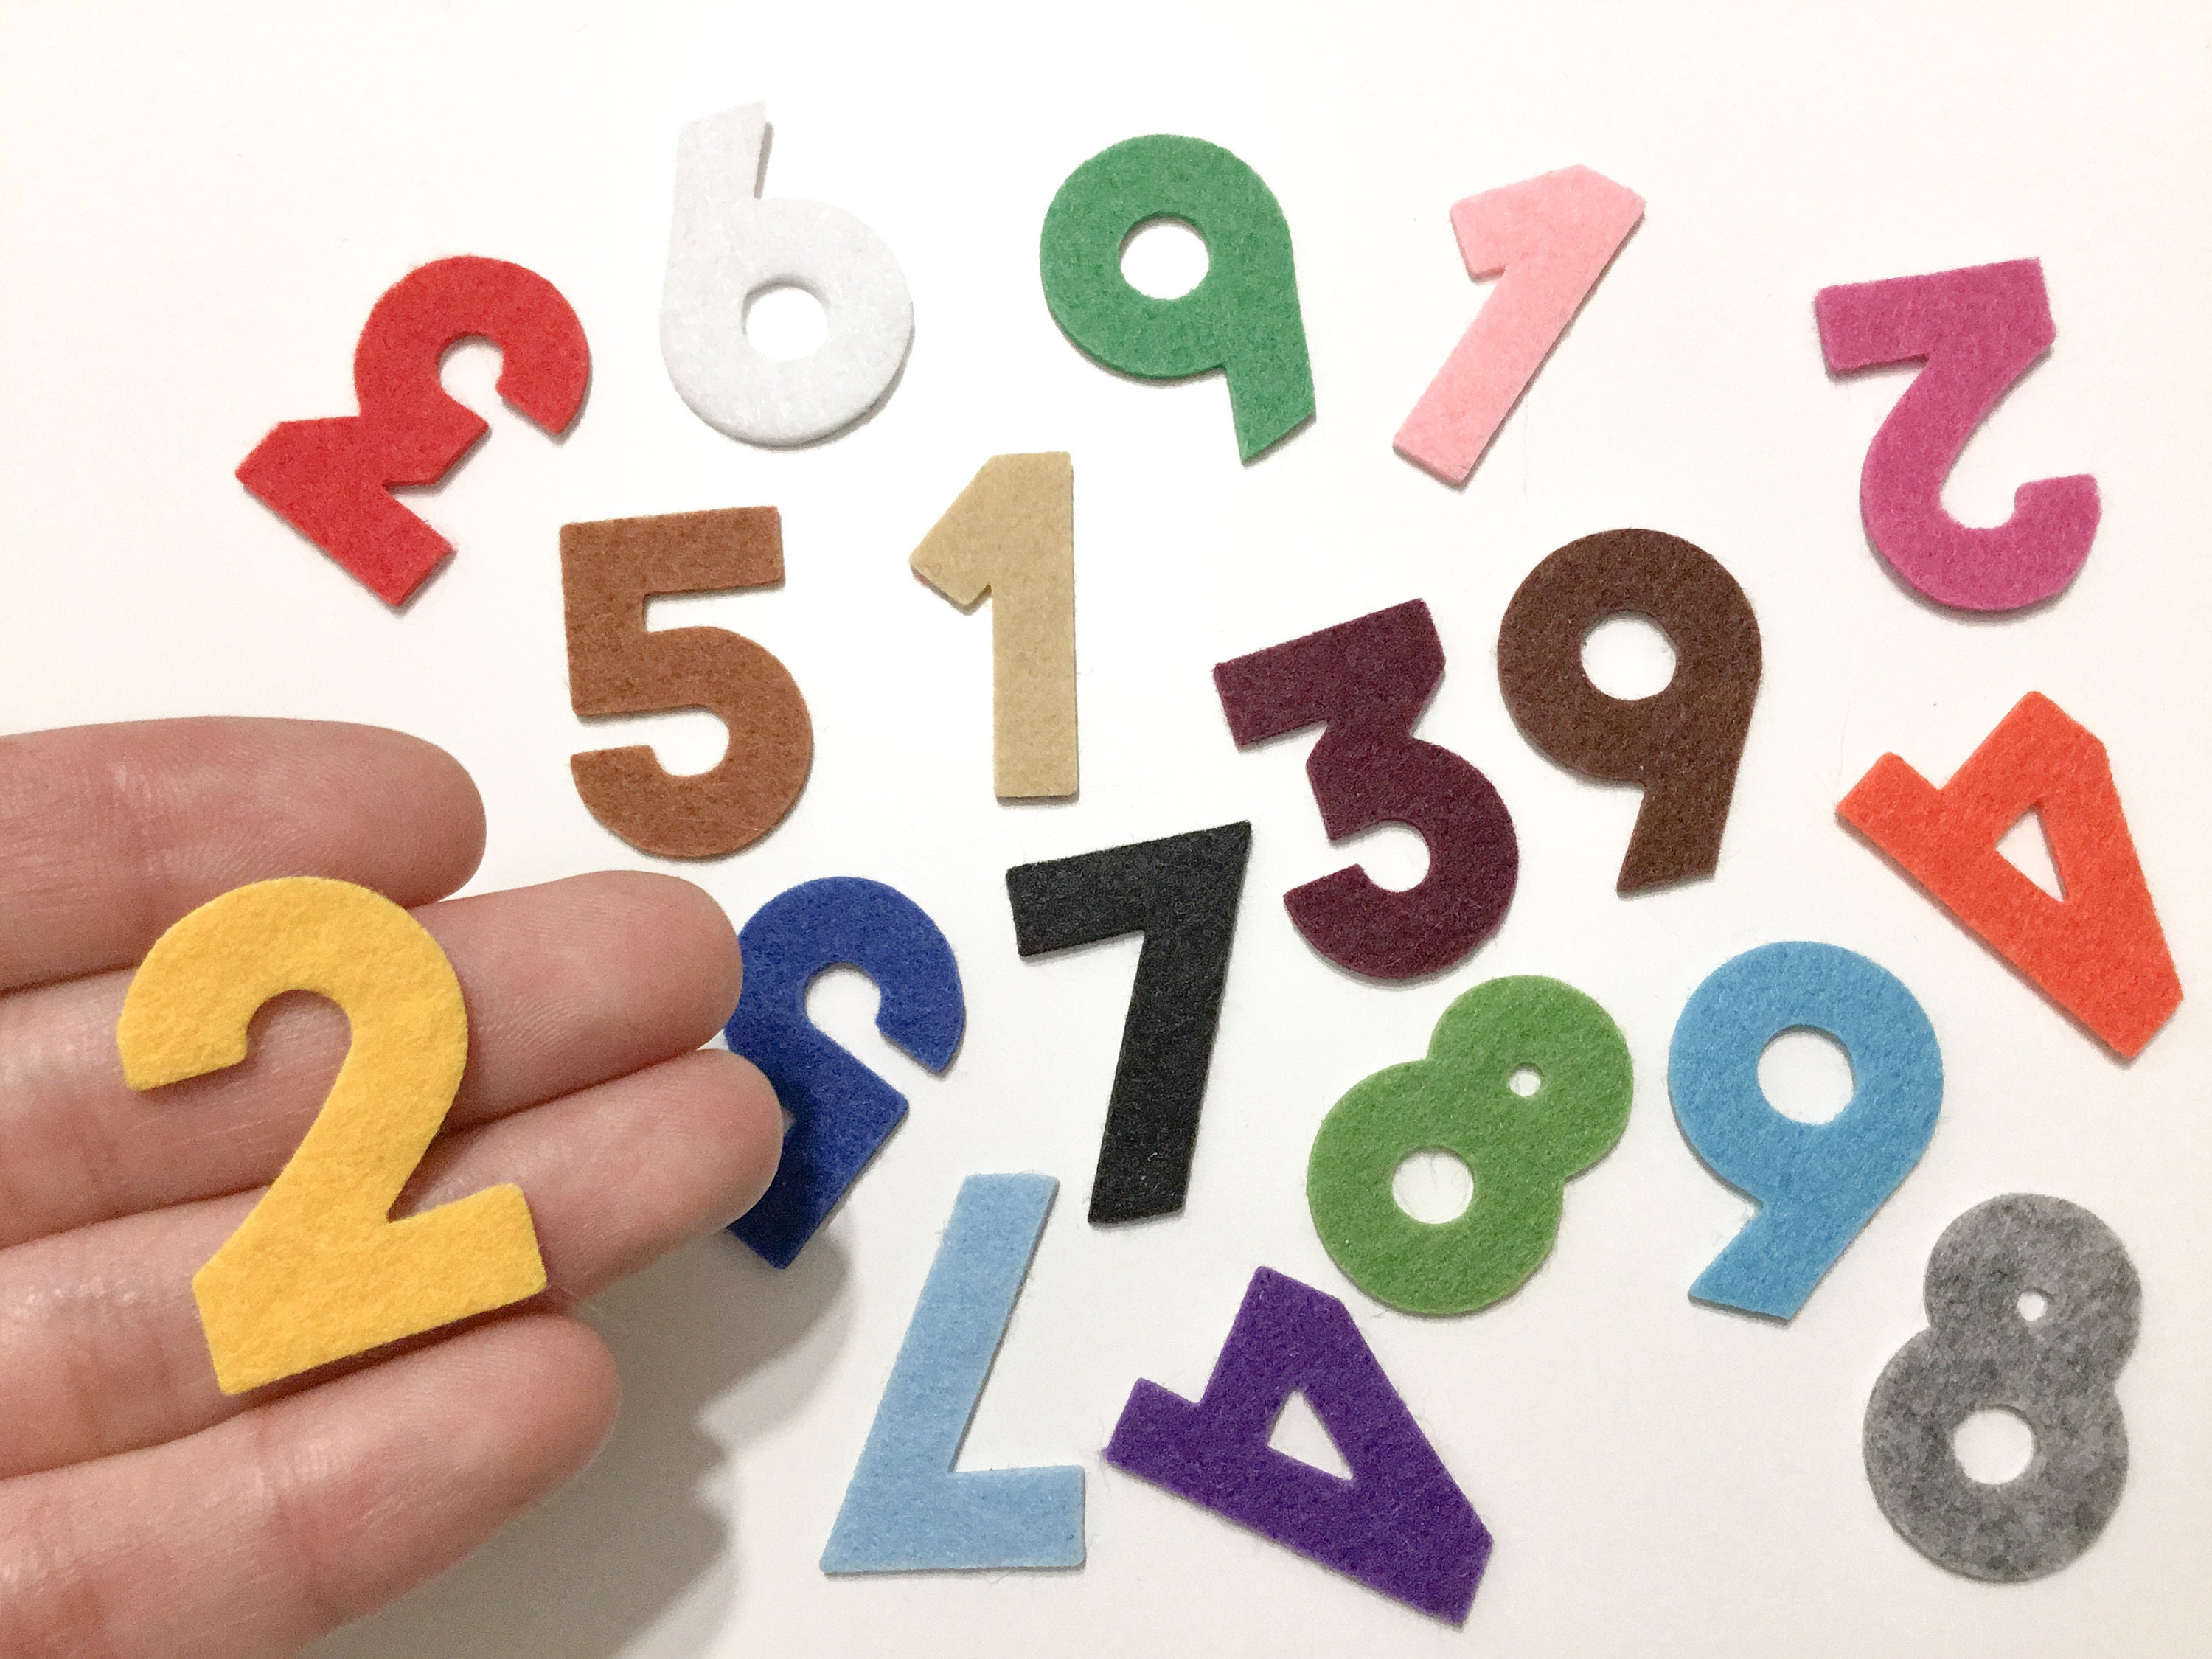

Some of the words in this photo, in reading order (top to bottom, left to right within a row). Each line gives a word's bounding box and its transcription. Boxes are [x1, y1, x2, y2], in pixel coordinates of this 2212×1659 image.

[234, 254, 592, 612] 3
[659, 100, 915, 447] 6
[1040, 134, 1317, 465] 9
[1394, 164, 1646, 488] 1
[1814, 257, 2101, 616] 2
[560, 505, 815, 859] 5
[908, 451, 1079, 802] 1
[1214, 598, 1519, 984] 3
[1497, 529, 1762, 897] 9
[1006, 821, 1253, 1227] 7
[1836, 690, 2184, 1064] 4
[116, 876, 548, 1395] 2
[1307, 976, 1635, 1318] 8
[1668, 941, 1944, 1323] 9
[822, 1173, 1087, 1576] 7
[1103, 1267, 1493, 1627] 4
[1863, 1193, 2143, 1581] 8
